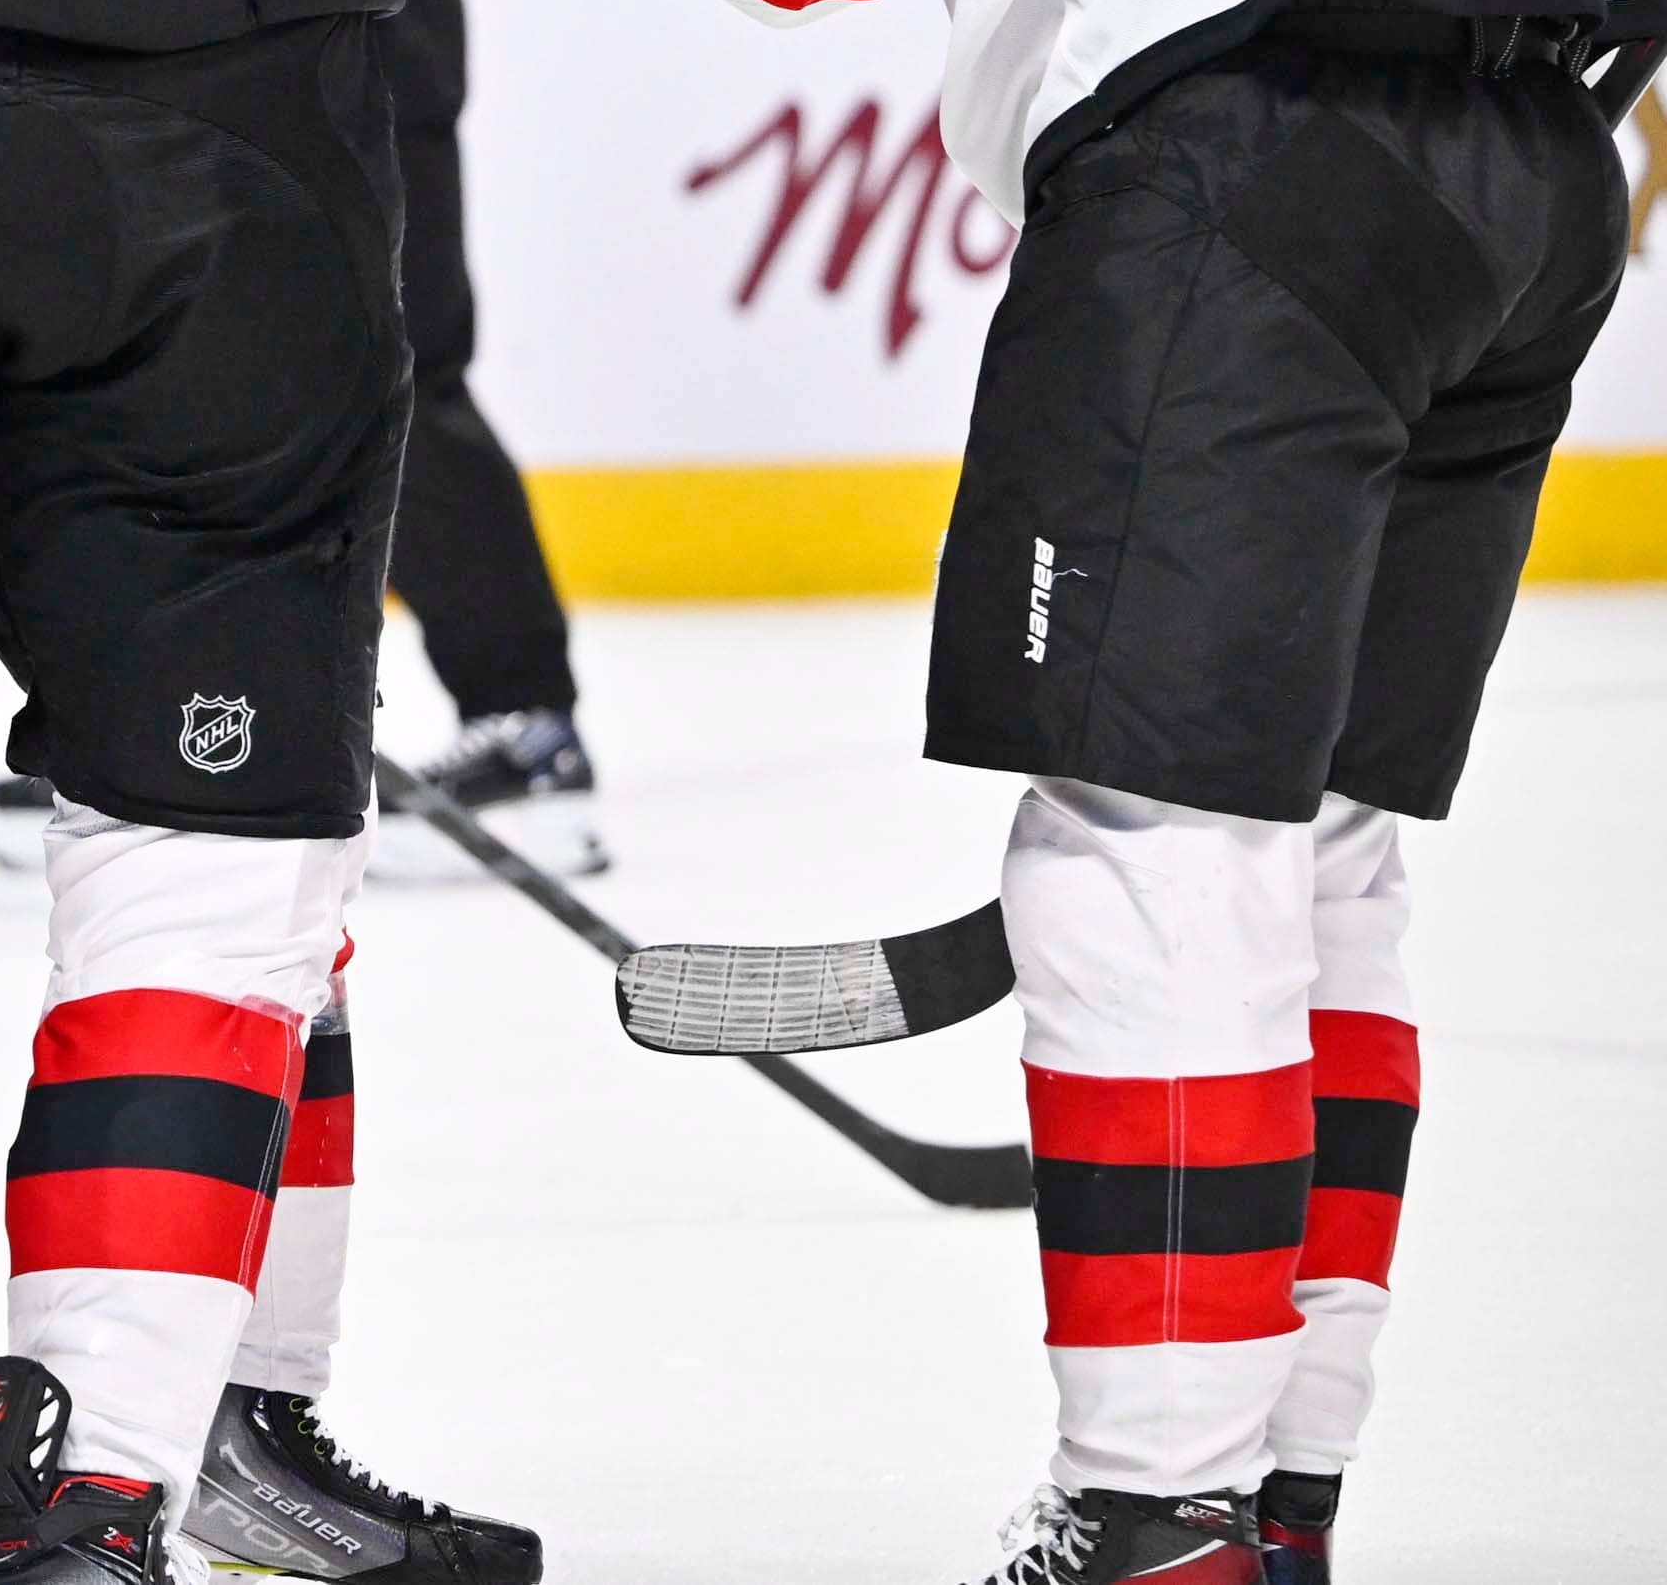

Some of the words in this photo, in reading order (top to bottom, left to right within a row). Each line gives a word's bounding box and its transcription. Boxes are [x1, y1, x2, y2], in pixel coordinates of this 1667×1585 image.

[1024, 537, 1055, 664] BAUER
[196, 716, 239, 755] NHL
[253, 1482, 363, 1556] BAUER
